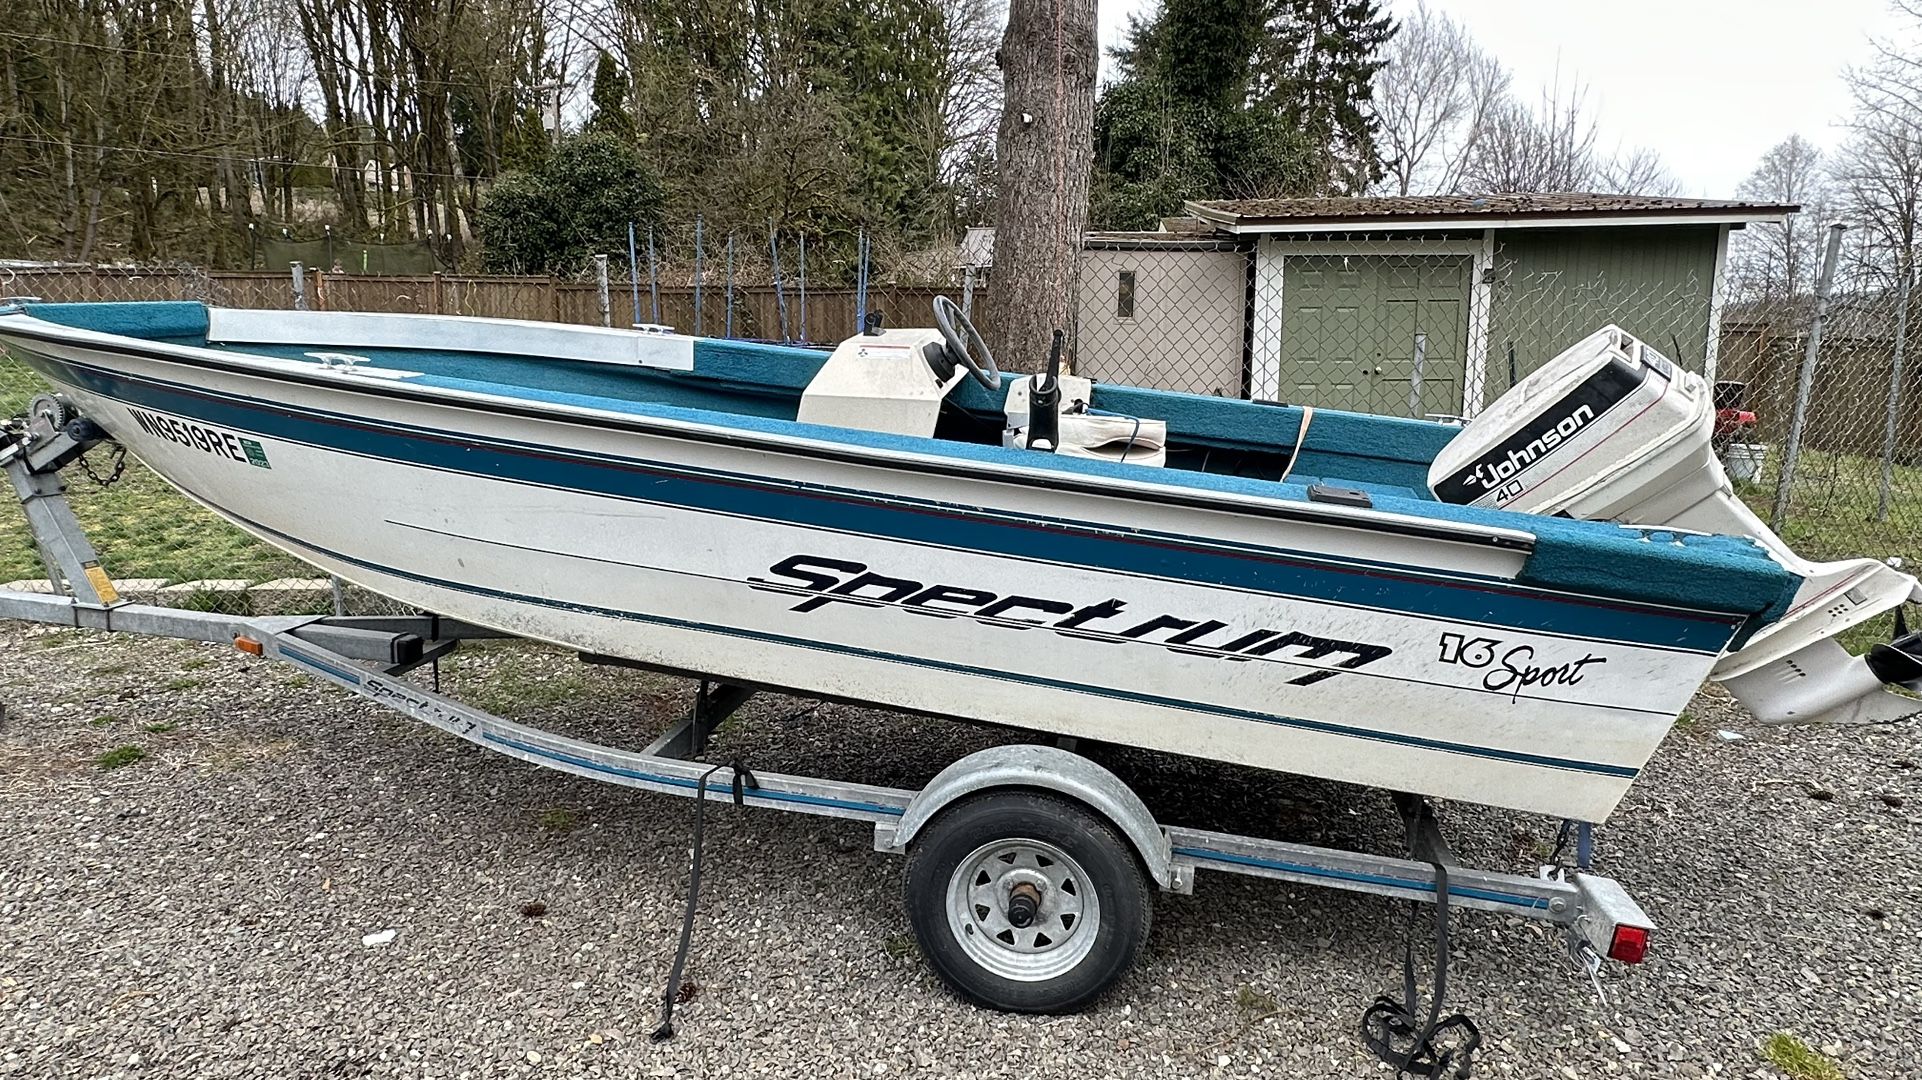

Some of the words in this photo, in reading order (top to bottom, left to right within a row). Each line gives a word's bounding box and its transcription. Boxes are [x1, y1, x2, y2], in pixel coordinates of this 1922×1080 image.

[1481, 404, 1594, 489] Johnson
[1496, 479, 1524, 502] 40
[746, 554, 1393, 687] Spectrum
[1438, 631, 1504, 668] 16
[1482, 645, 1607, 704] Sport
